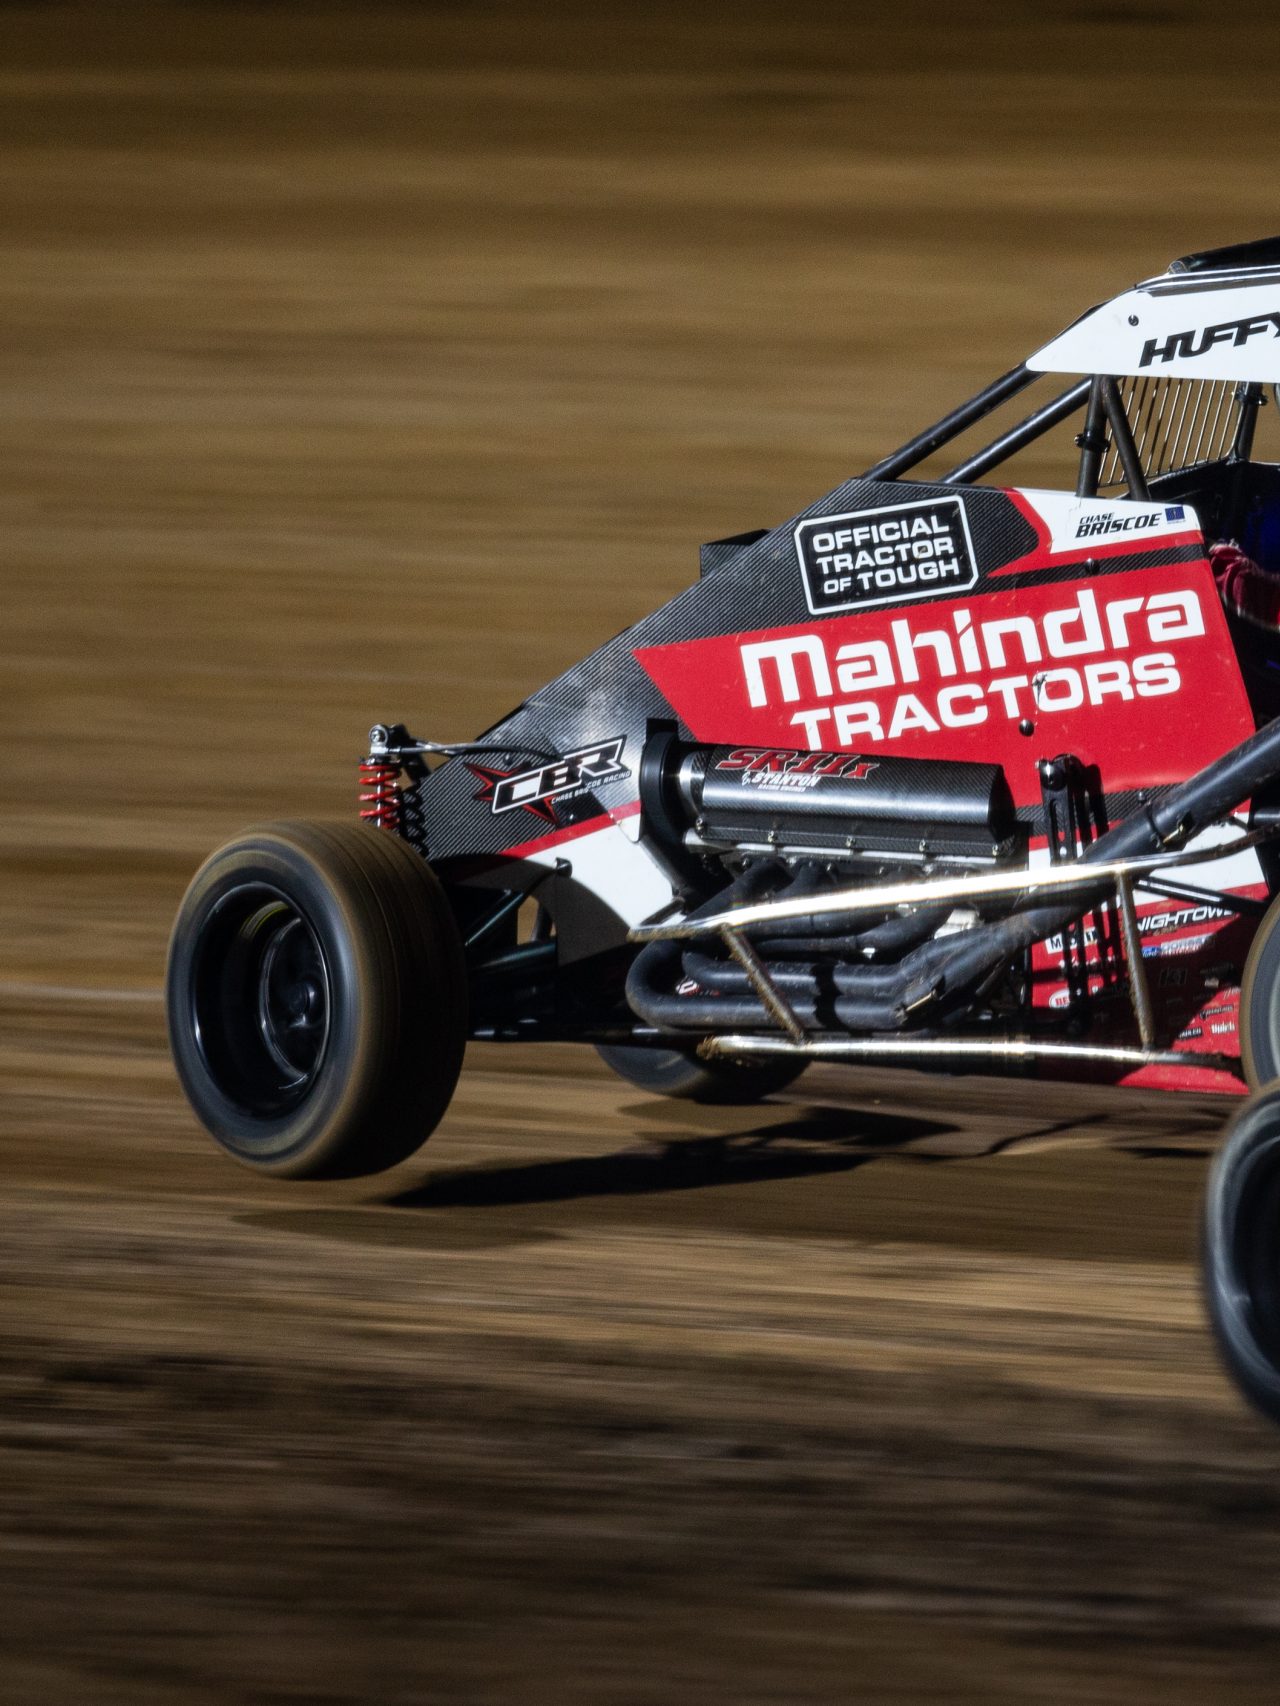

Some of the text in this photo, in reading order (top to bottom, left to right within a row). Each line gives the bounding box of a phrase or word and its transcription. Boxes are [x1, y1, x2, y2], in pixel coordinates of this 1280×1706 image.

[813, 512, 950, 554] OFFICIAL
[1075, 512, 1163, 538] BRISCOE
[1079, 511, 1115, 525] CHASE
[816, 537, 955, 575] TRACTOR
[823, 557, 959, 594] OF TOUGH
[741, 588, 1206, 708] Mahindra
[790, 653, 1182, 751] TRACTORS
[752, 771, 822, 788] STANTON
